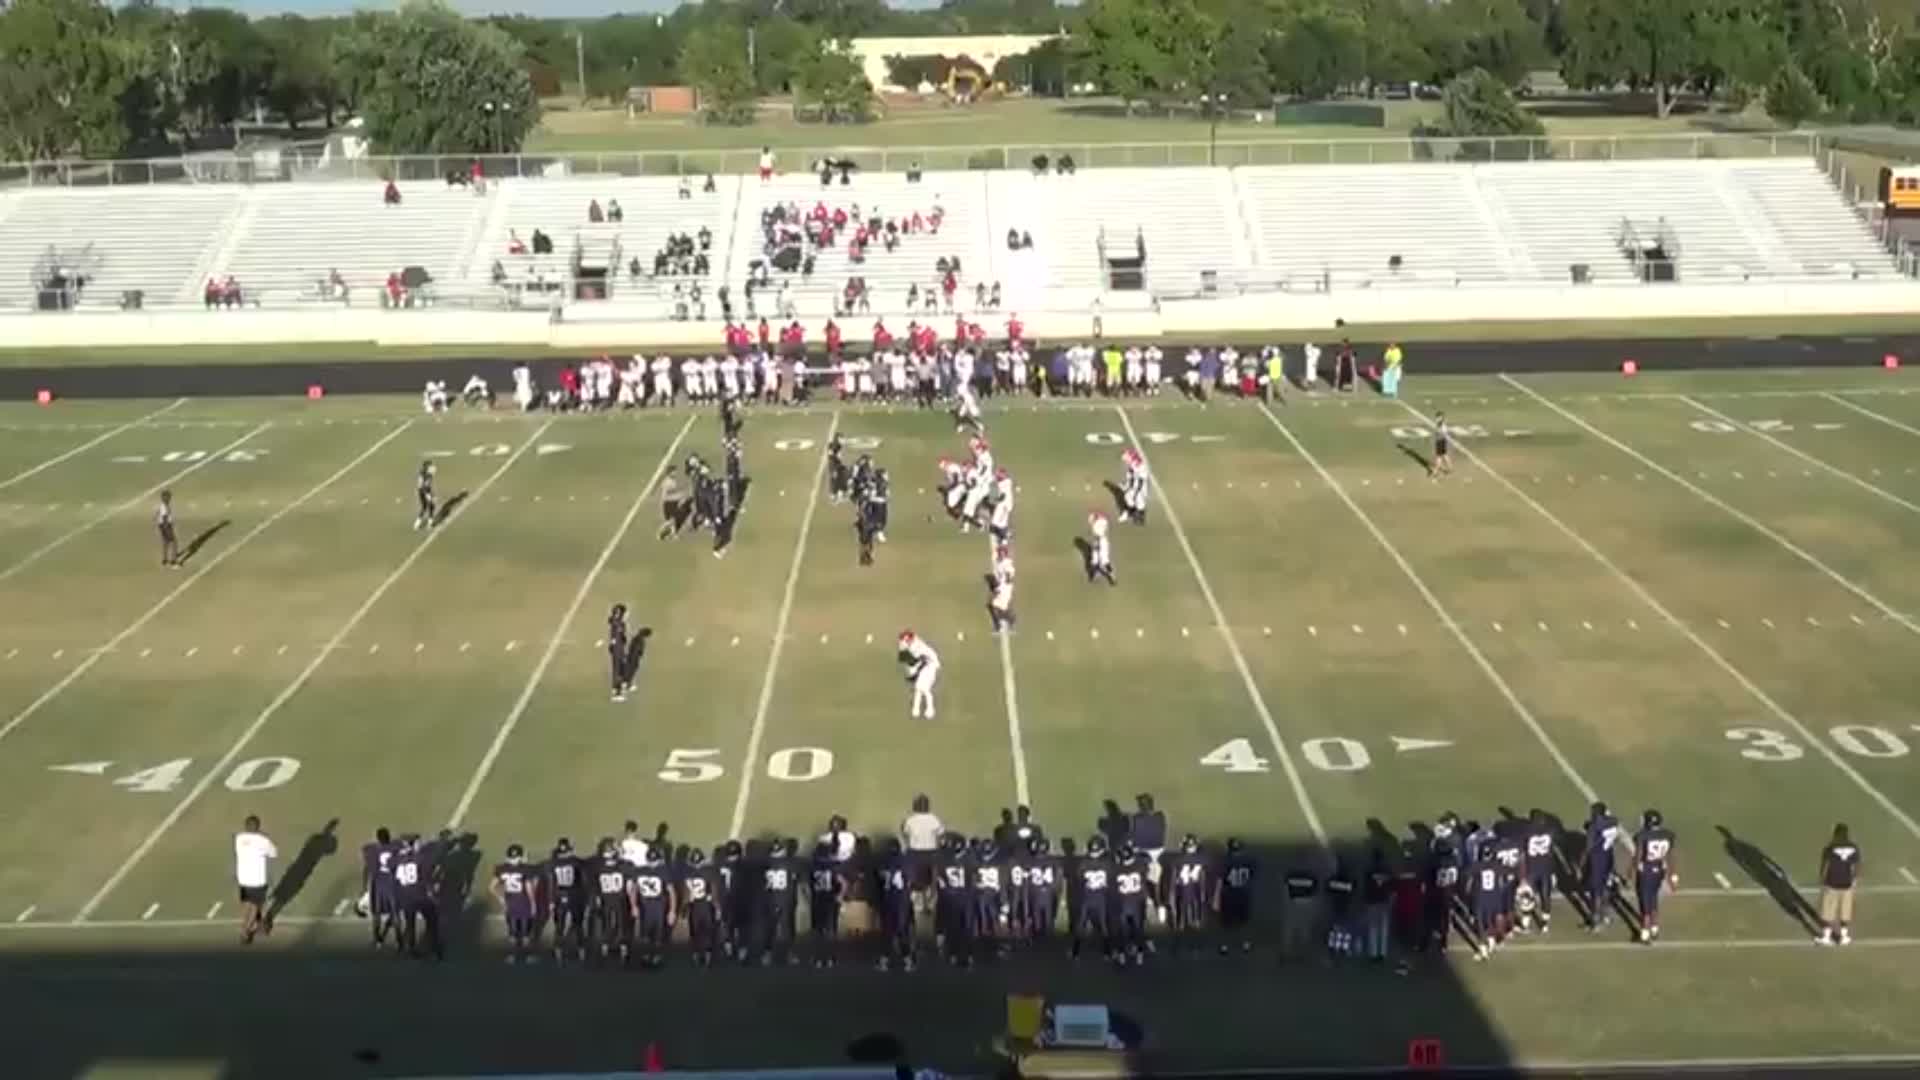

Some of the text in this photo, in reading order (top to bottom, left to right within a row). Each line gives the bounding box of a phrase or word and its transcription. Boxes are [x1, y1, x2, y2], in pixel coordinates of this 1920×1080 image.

[1200, 737, 1371, 773] 40
[1724, 725, 1910, 761] 30
[112, 757, 301, 793] 40
[657, 747, 834, 784] 50
[396, 863, 418, 885] 48
[637, 876, 662, 897] 53
